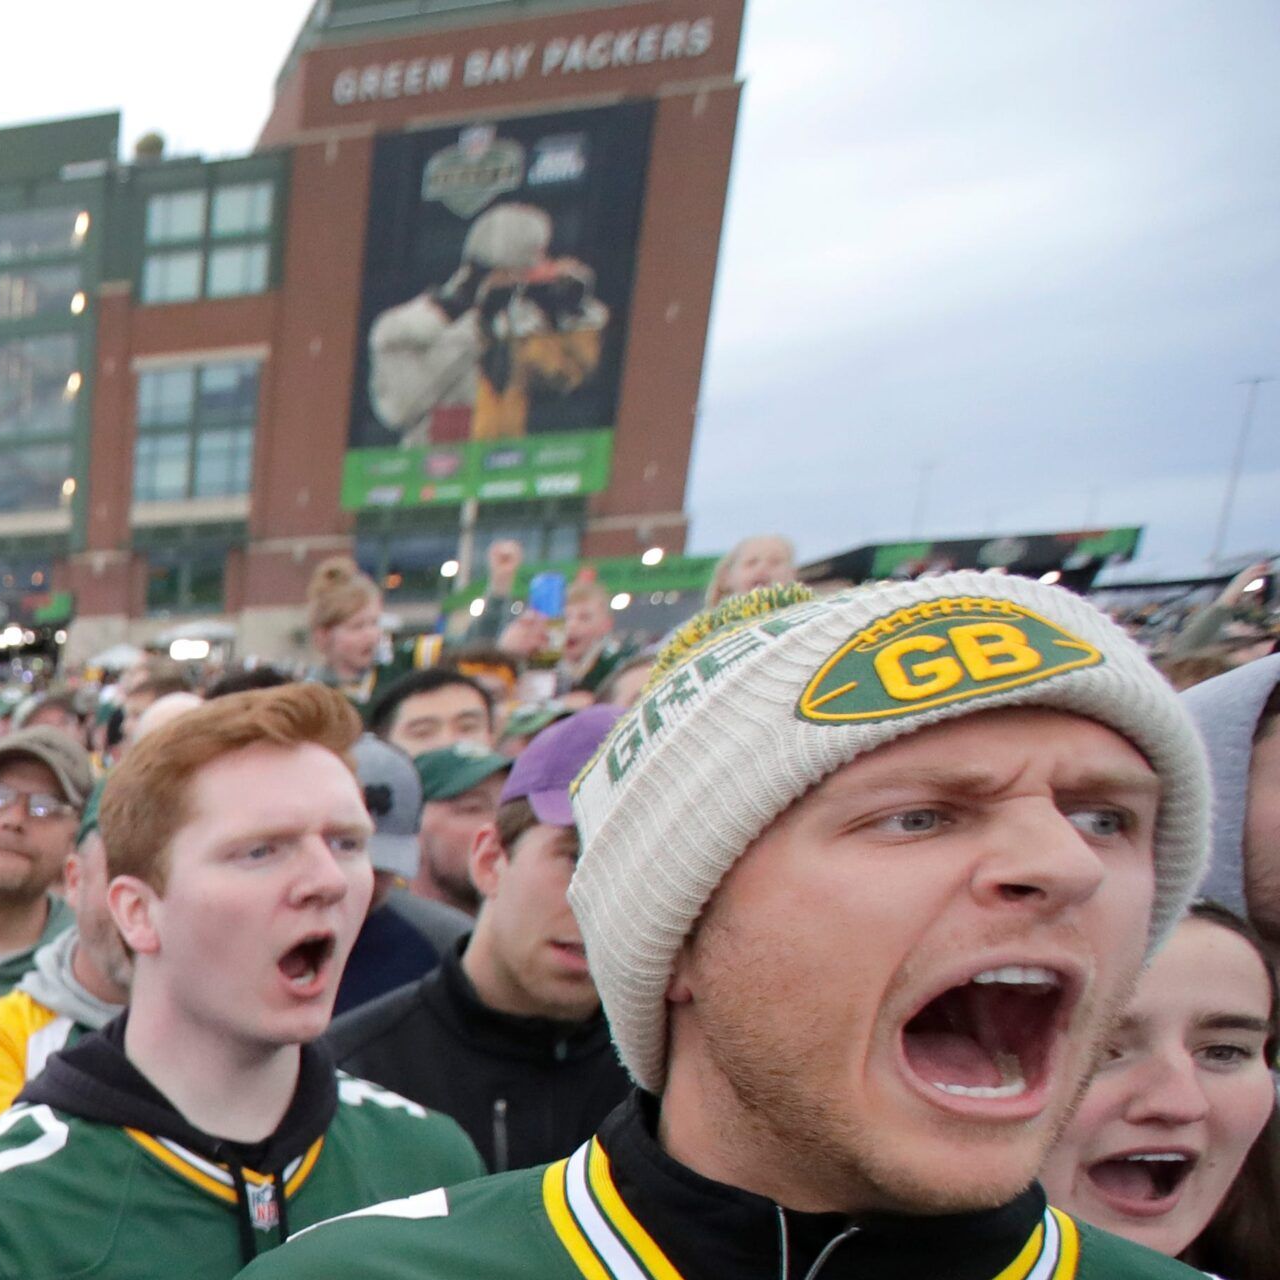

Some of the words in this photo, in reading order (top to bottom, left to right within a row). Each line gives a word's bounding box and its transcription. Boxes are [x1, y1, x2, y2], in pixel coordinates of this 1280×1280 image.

[332, 54, 454, 106] GREEN
[463, 41, 535, 88] BAY
[542, 17, 713, 76] PACKERS
[606, 596, 851, 784] GREE
[873, 621, 1043, 702] GB
